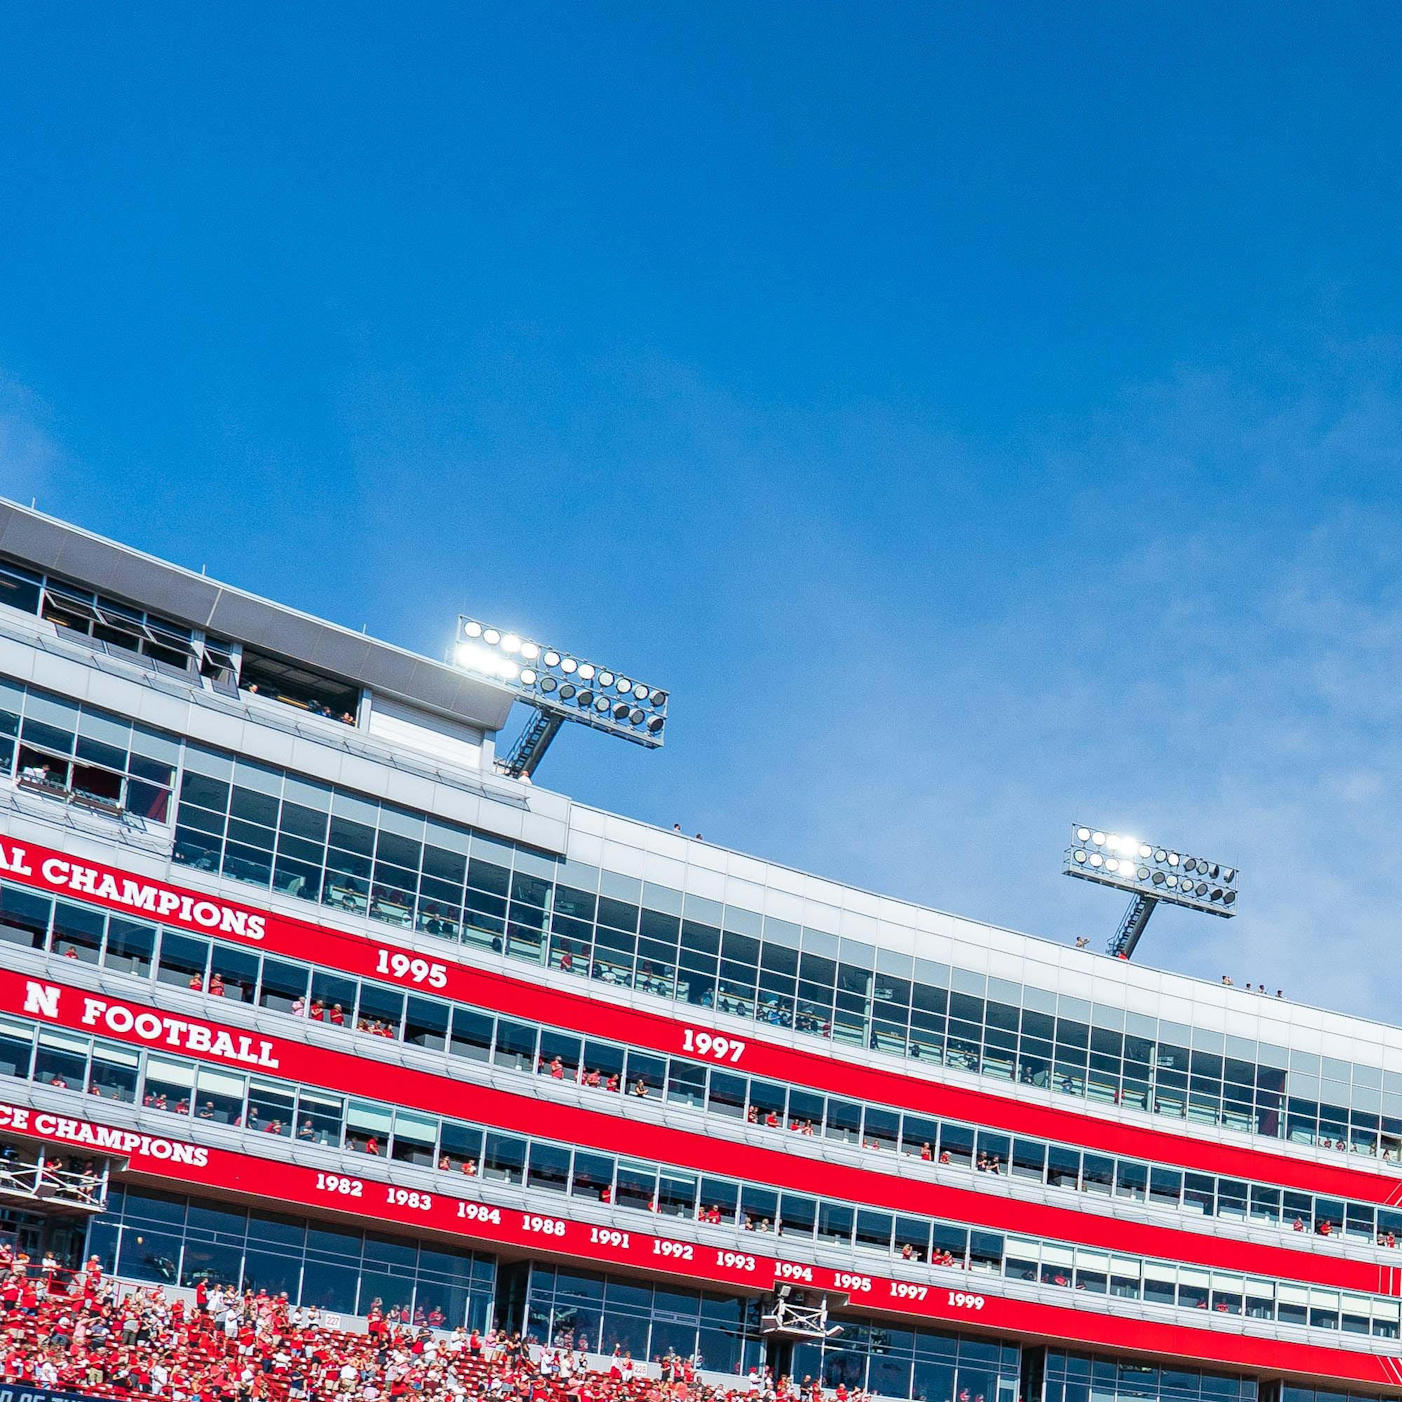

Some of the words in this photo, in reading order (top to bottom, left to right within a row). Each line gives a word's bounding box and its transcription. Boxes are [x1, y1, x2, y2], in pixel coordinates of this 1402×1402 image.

[41, 858, 267, 941] CHAMPIONS
[376, 949, 447, 988] 1995
[23, 981, 62, 1018] N
[82, 997, 280, 1070] FOOTBALL
[682, 1029, 745, 1063] 1997
[34, 1114, 209, 1169] CHAMPIONS
[315, 1173, 363, 1198] 1982
[386, 1187, 432, 1211] 1983
[457, 1202, 501, 1225] 1984
[522, 1215, 566, 1237] 1988
[590, 1227, 630, 1249] 1991
[653, 1239, 694, 1261] 1992
[716, 1251, 756, 1272] 1993
[774, 1261, 813, 1283] 1994
[833, 1272, 872, 1293] 1995
[890, 1282, 927, 1302] 1997
[947, 1291, 985, 1311] 1999
